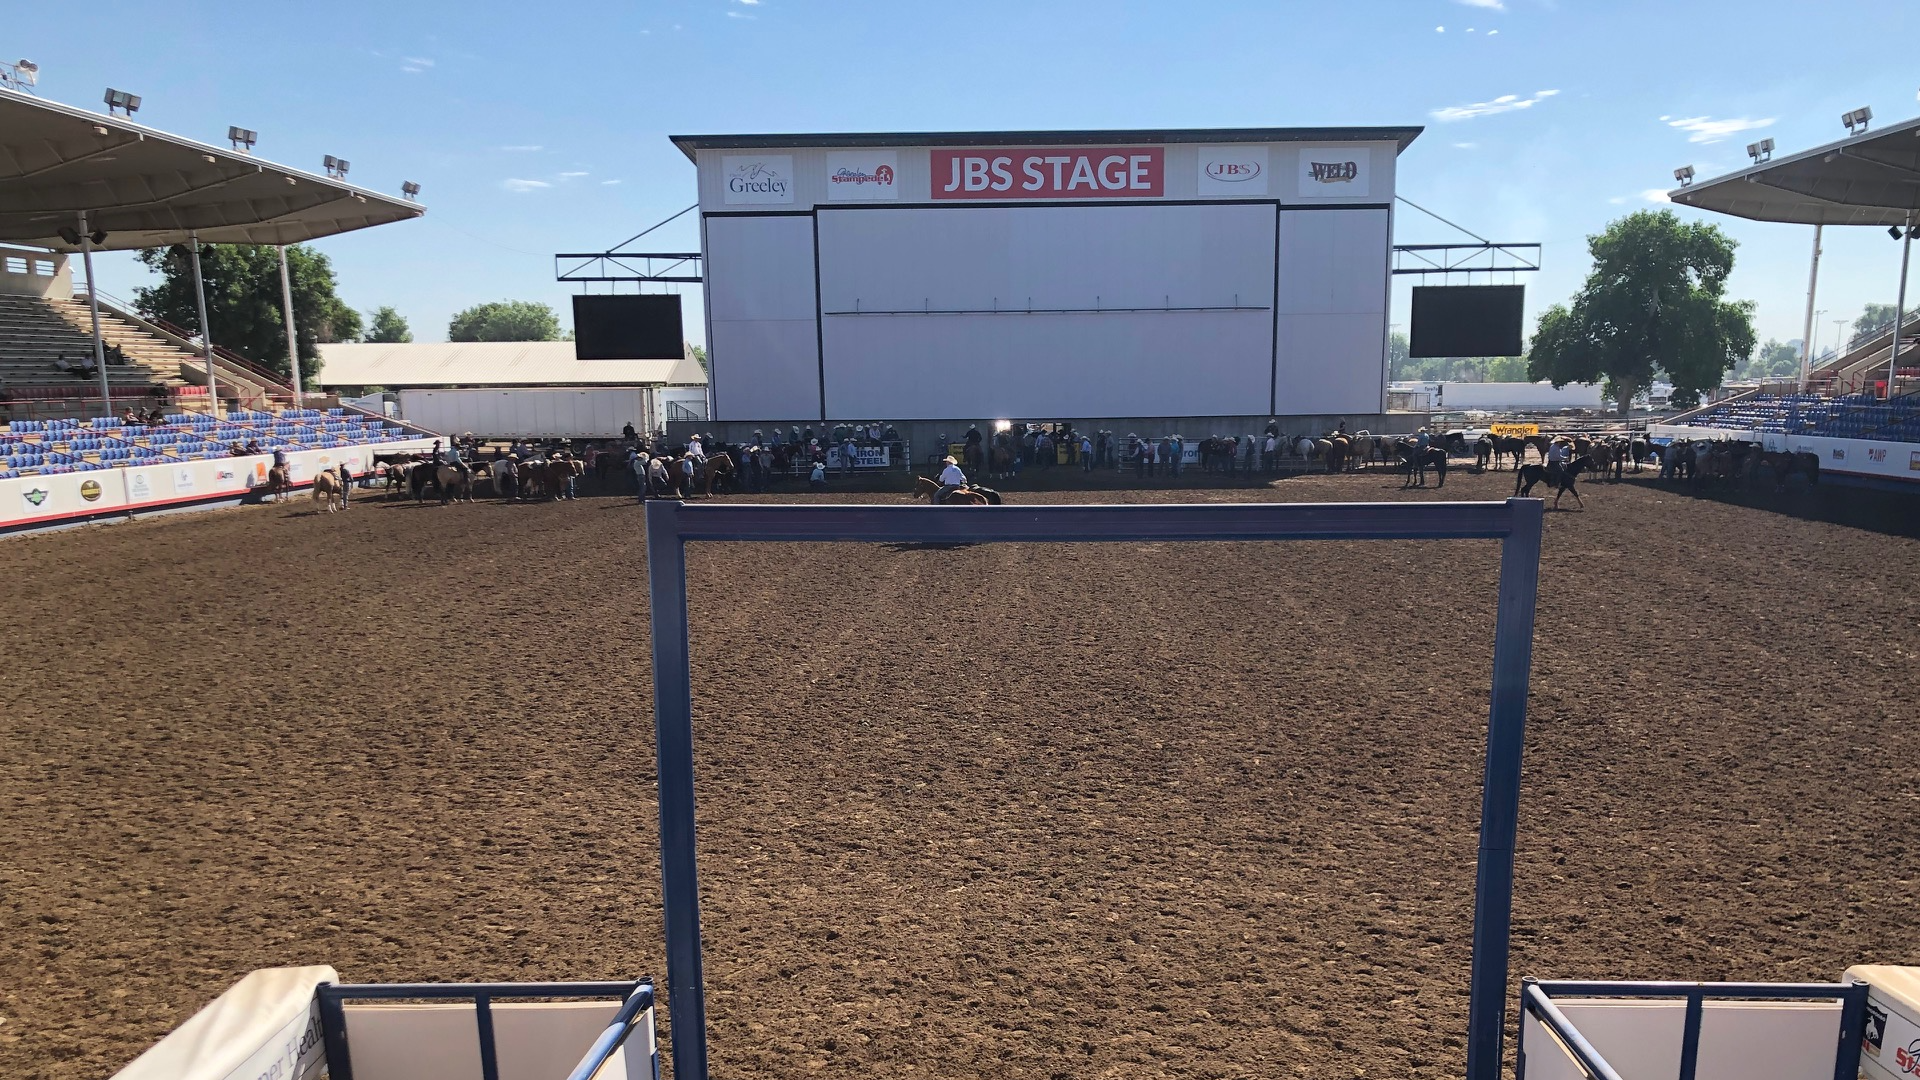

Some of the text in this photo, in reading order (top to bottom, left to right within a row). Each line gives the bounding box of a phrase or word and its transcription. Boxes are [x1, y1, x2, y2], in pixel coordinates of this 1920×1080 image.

[944, 155, 1152, 192] JBS STAGE
[1213, 164, 1251, 175] JBS
[1311, 161, 1357, 181] WELD
[729, 177, 788, 197] Greeley
[1495, 425, 1535, 438] Wrangler
[855, 457, 886, 465] STEEL
